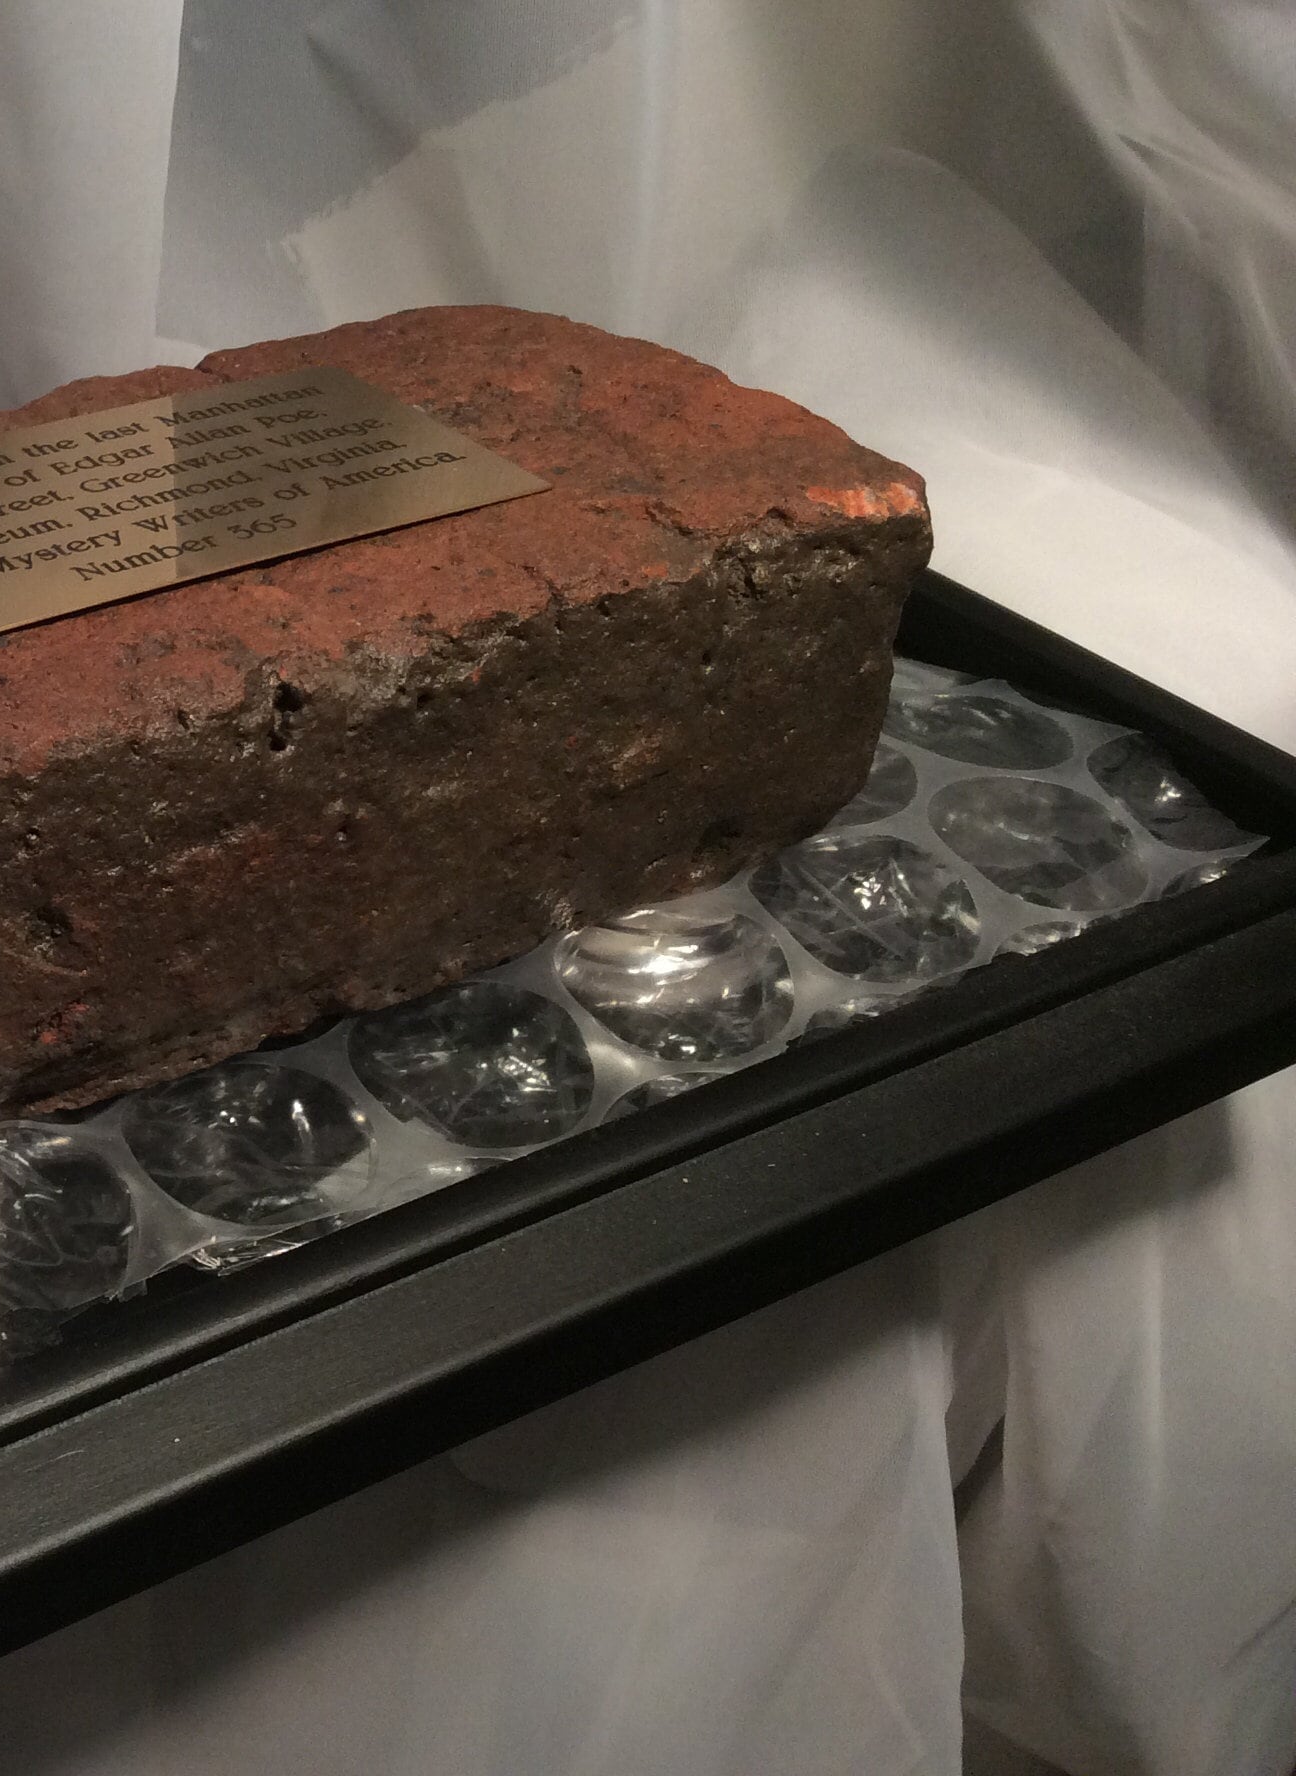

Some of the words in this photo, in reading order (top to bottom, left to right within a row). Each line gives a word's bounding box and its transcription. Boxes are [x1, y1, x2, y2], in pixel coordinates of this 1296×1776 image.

[21, 439, 79, 459] the
[85, 421, 150, 443] last
[154, 385, 325, 427] Manhattan
[4, 468, 42, 487] of
[48, 443, 155, 476] Edgar
[167, 423, 251, 449] Allan
[80, 444, 263, 493] Greenwich
[131, 495, 265, 533] Writers
[273, 482, 311, 501] of
[69, 534, 218, 582] Number
[227, 513, 297, 540] 365
